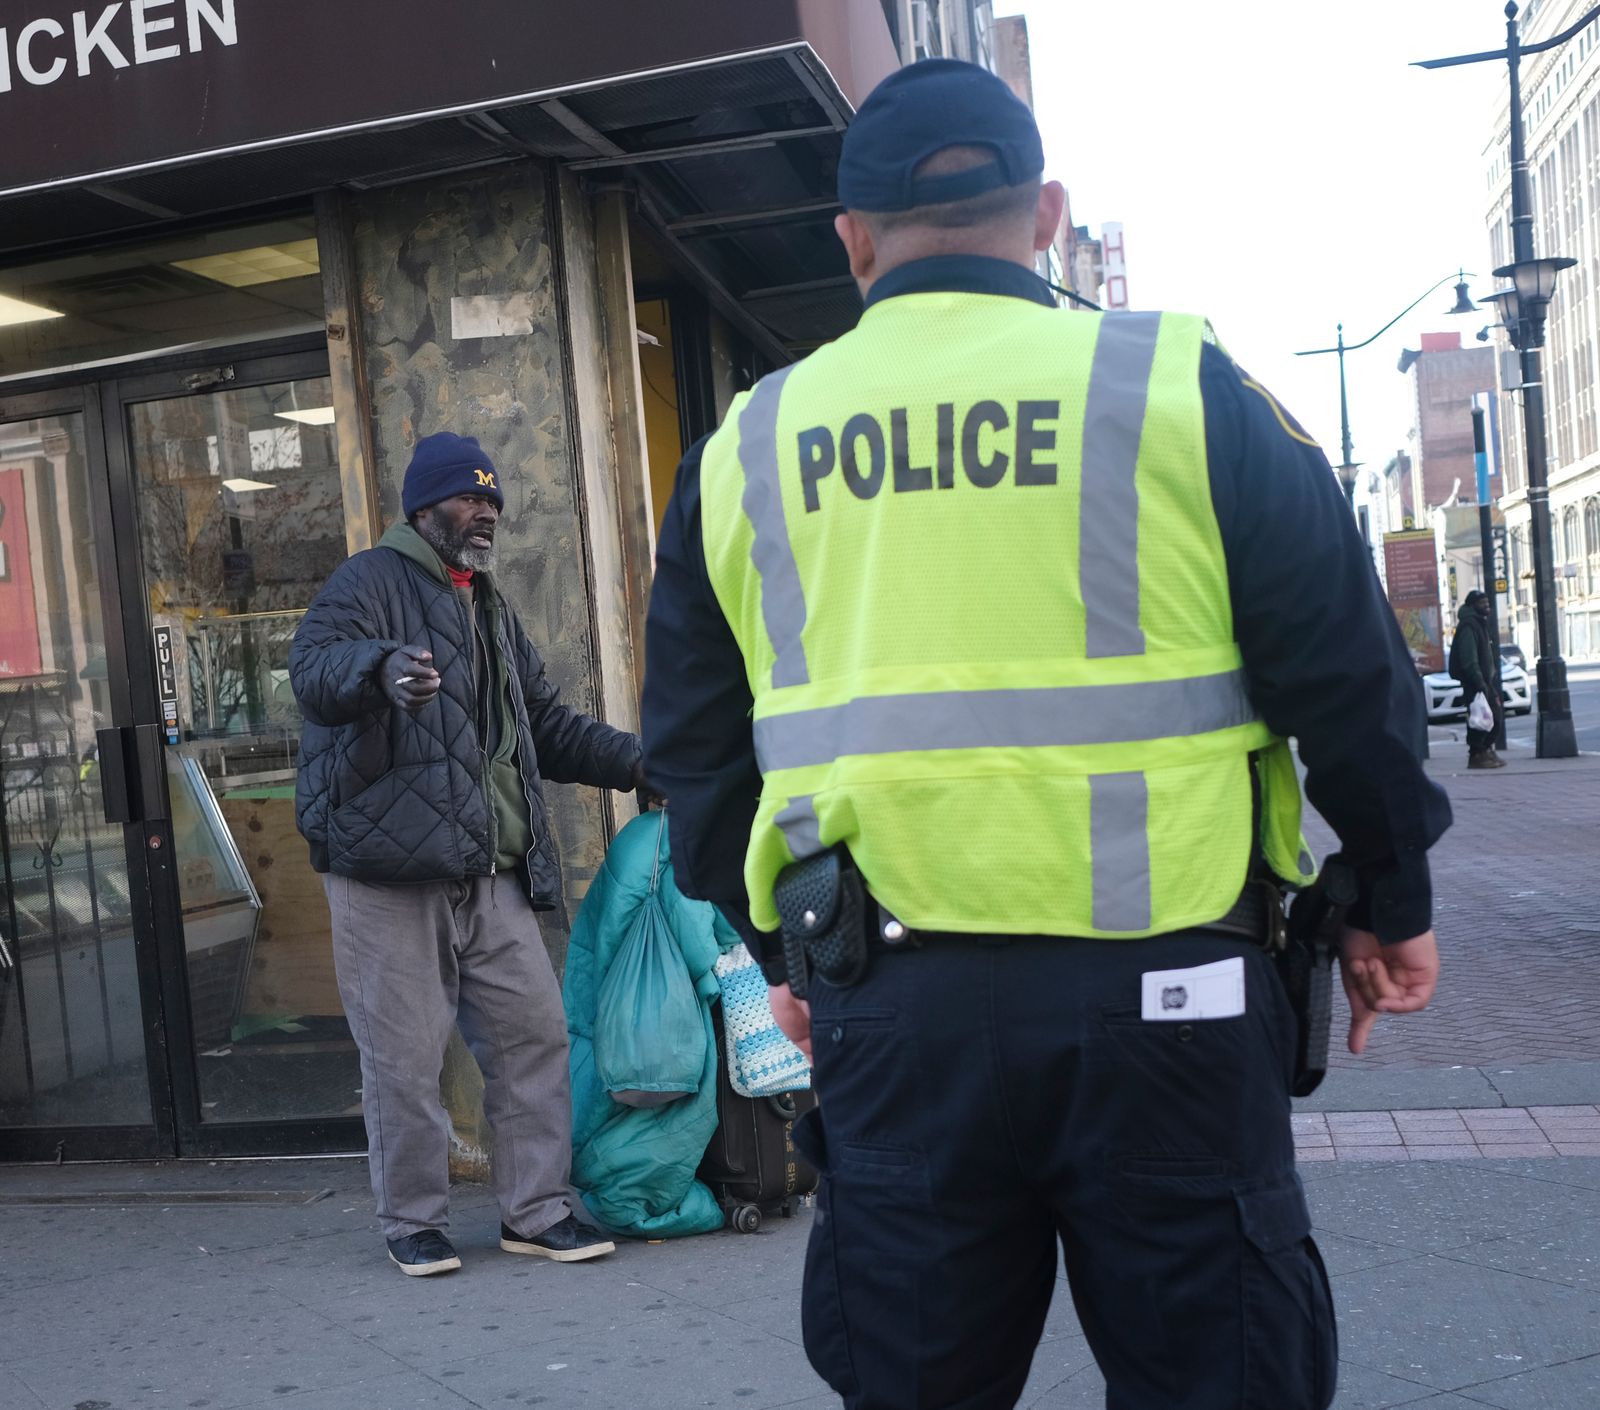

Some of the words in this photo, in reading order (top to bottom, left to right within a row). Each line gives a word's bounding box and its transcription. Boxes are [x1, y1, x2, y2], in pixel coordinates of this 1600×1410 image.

[474, 469, 497, 489] M
[797, 399, 1060, 513] POLICE
[157, 633, 173, 694] PULL
